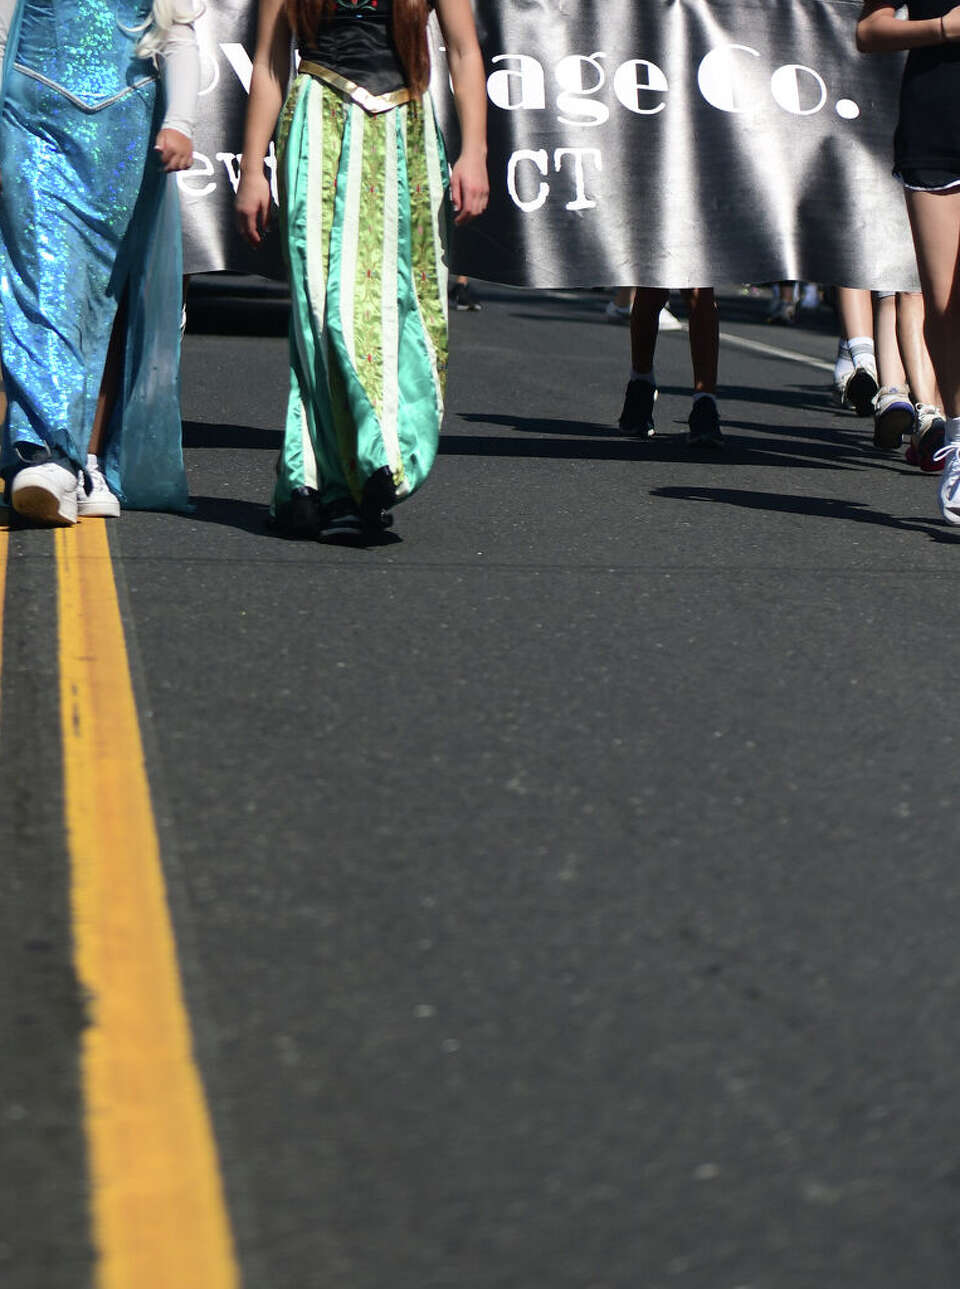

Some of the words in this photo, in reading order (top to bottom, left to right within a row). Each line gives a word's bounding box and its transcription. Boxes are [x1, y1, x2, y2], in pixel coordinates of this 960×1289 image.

[487, 52, 669, 126] age
[698, 44, 860, 120] Co.
[507, 148, 602, 212] CT
